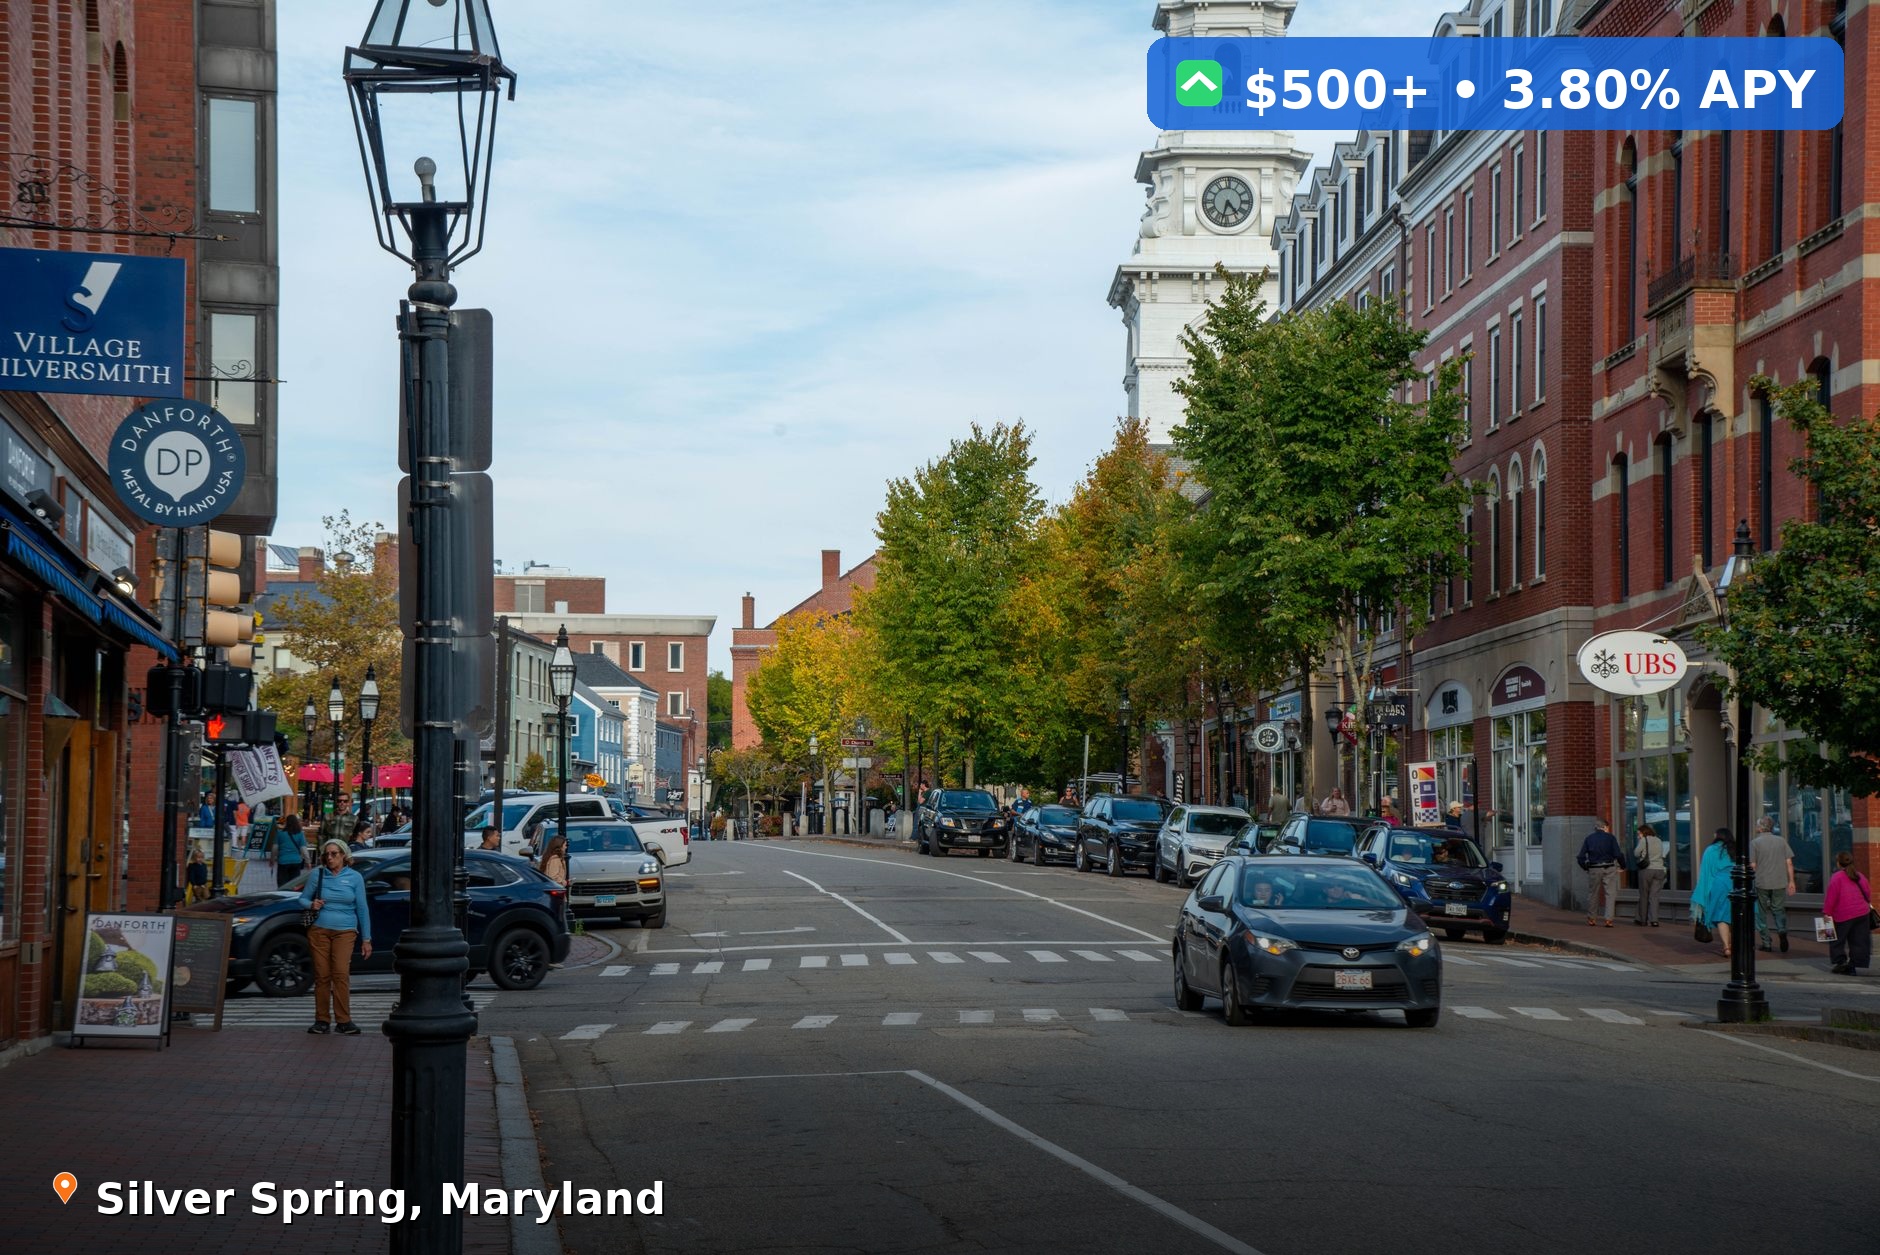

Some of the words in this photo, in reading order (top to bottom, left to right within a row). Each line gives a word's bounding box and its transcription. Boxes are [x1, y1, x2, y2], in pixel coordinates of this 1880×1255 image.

[14, 331, 142, 359] VILLAGE
[1, 357, 172, 385] ILVERSMITH
[157, 447, 203, 477] DP
[121, 468, 151, 509] METAL
[154, 503, 174, 516] BY
[177, 495, 216, 517] HAND
[214, 470, 234, 495] USA
[1623, 652, 1677, 675] UBS
[261, 744, 278, 784] NETT'S
[1411, 769, 1422, 822] OPEN
[96, 919, 166, 930] DANFORTH
